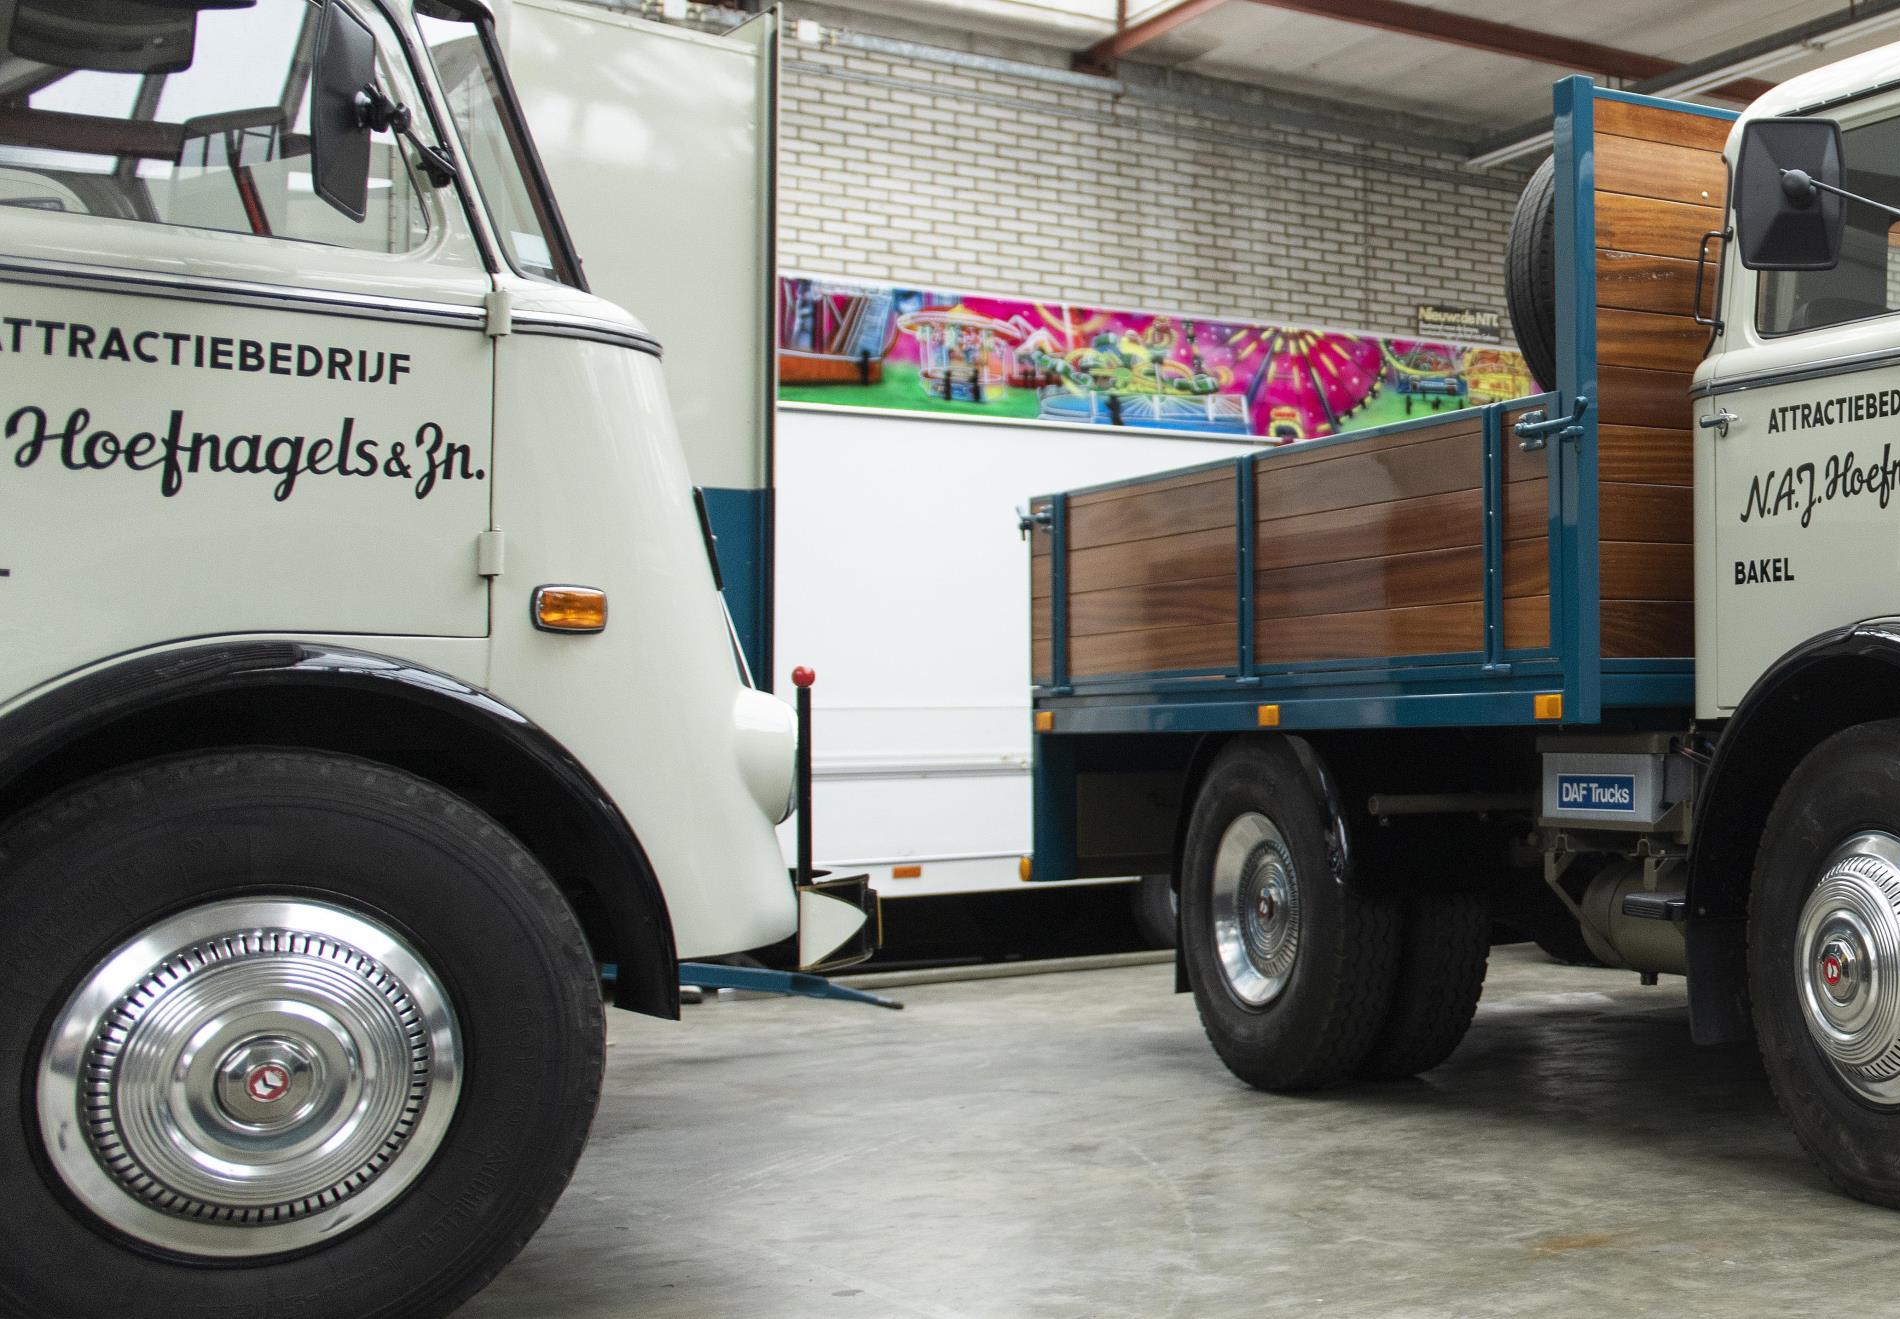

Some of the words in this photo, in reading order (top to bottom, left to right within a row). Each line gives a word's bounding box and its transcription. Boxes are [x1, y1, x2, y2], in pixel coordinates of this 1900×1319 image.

[0, 317, 411, 385] TTRACTIEBEDRIJF
[1734, 557, 1795, 585] BAKEL
[1562, 782, 1588, 802] DAF
[1589, 783, 1630, 804] Trucks
